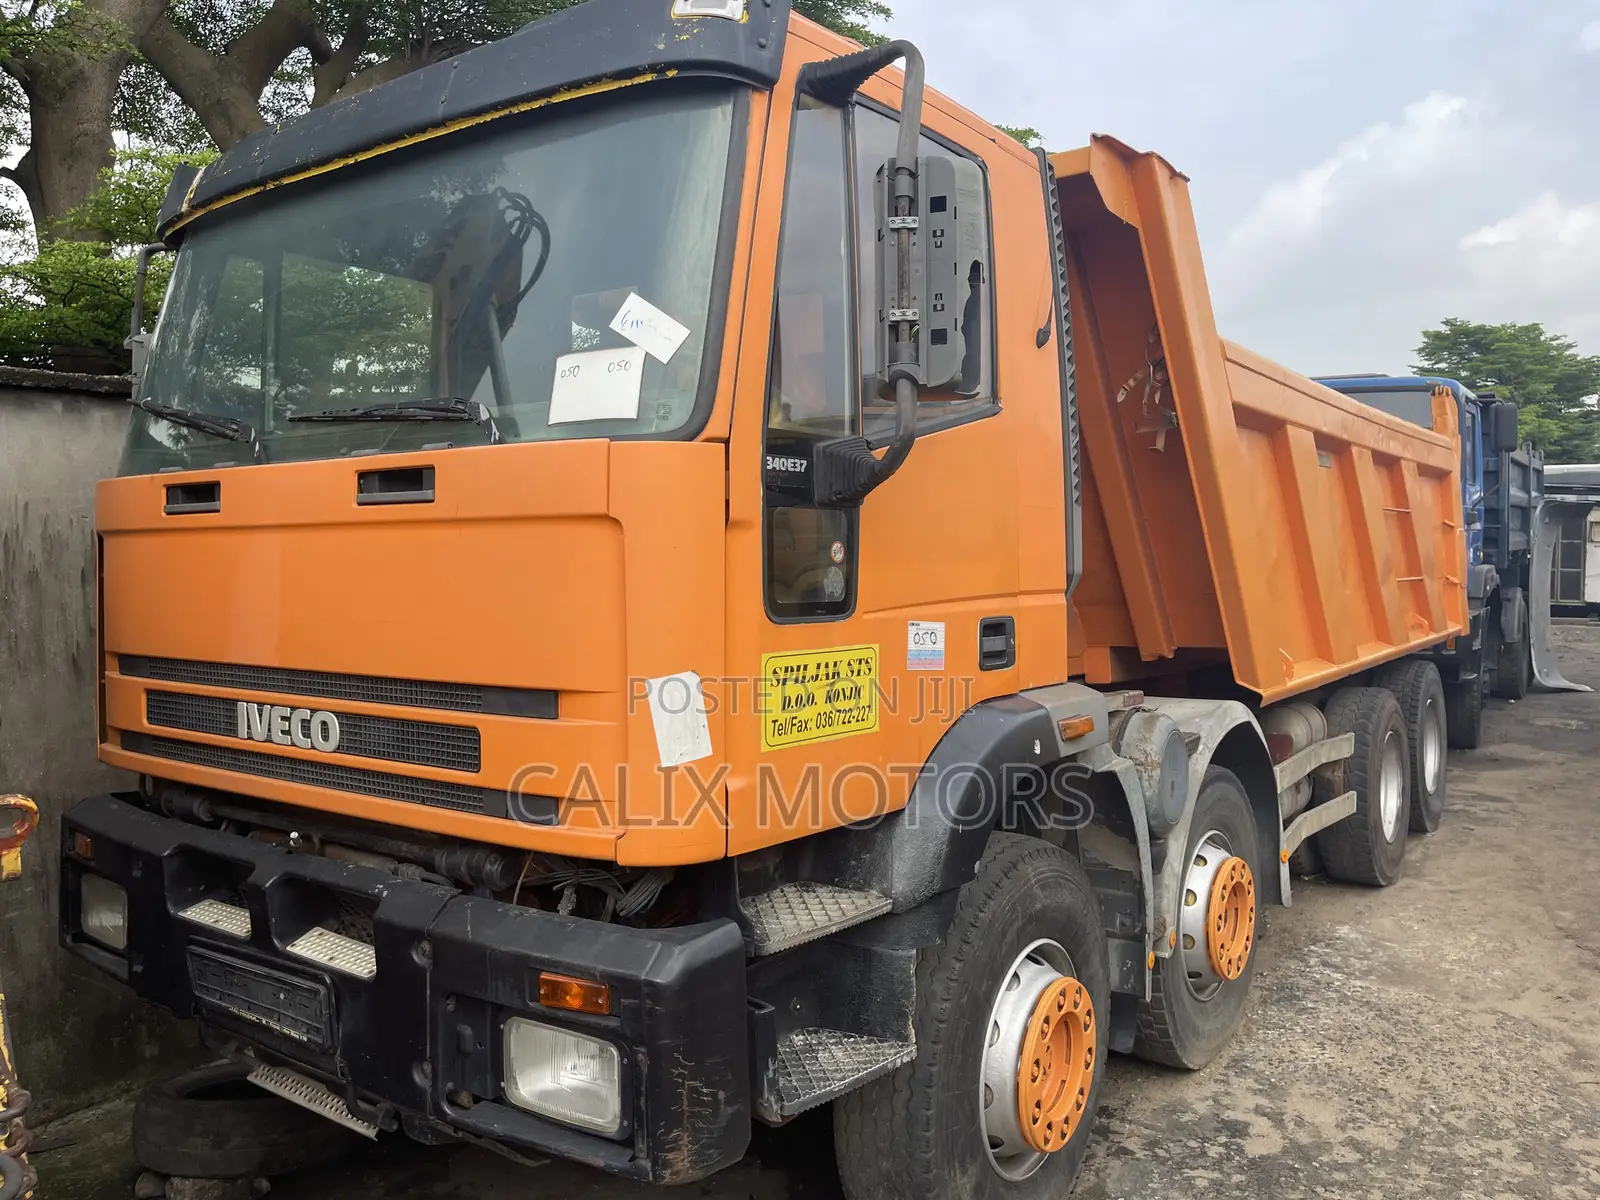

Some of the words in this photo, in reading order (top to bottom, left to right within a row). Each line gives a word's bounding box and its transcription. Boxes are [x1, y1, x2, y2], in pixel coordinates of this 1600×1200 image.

[561, 365, 580, 379] 050
[607, 360, 632, 373] 050
[766, 456, 808, 473] 340E37
[913, 631, 938, 646] 050
[770, 660, 843, 688] SPILJAK
[845, 657, 873, 678] STS
[781, 691, 818, 711] D.O.O.
[824, 685, 865, 704] KONJIC
[237, 701, 340, 753] IVECO
[771, 716, 814, 738] Tel/Fax:
[815, 704, 872, 729] 036/722-227
